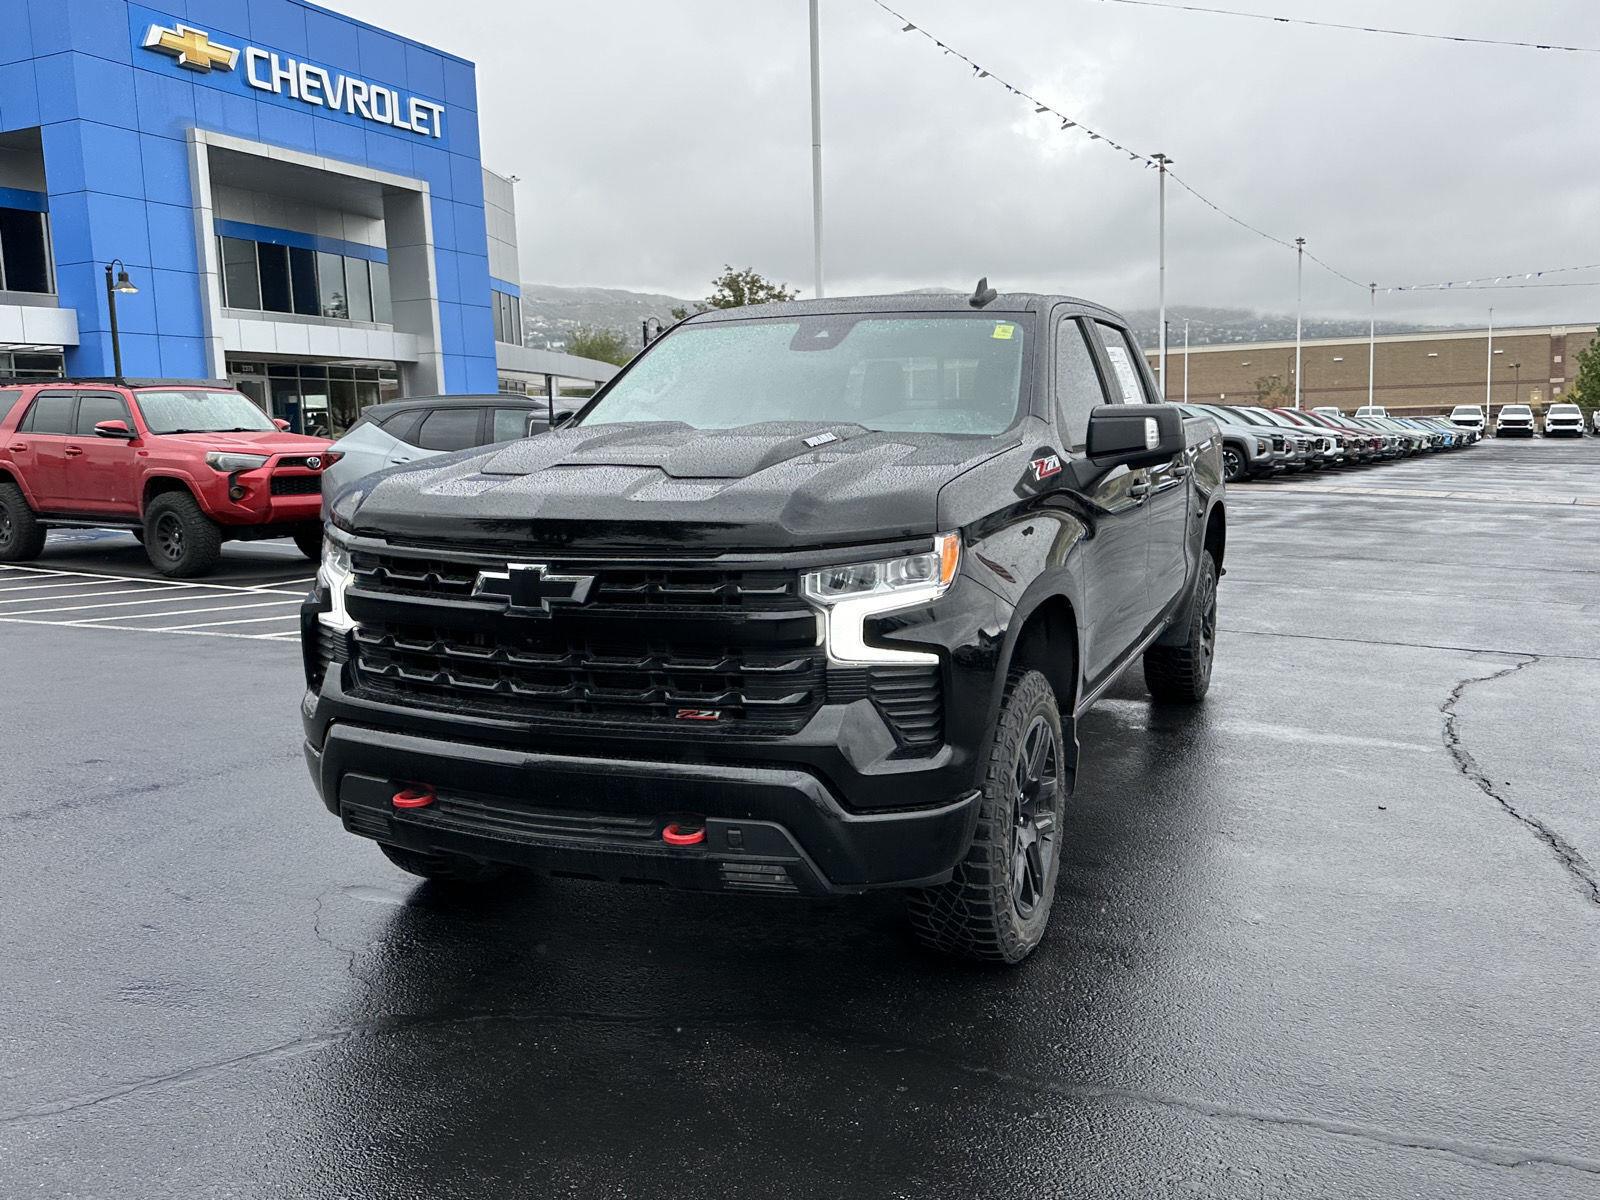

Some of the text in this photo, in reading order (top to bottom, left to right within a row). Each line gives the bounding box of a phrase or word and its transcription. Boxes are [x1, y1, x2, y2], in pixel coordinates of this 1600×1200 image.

[245, 46, 445, 138] CHEVROLET
[1030, 454, 1062, 481] Z71
[675, 709, 722, 721] Z71
